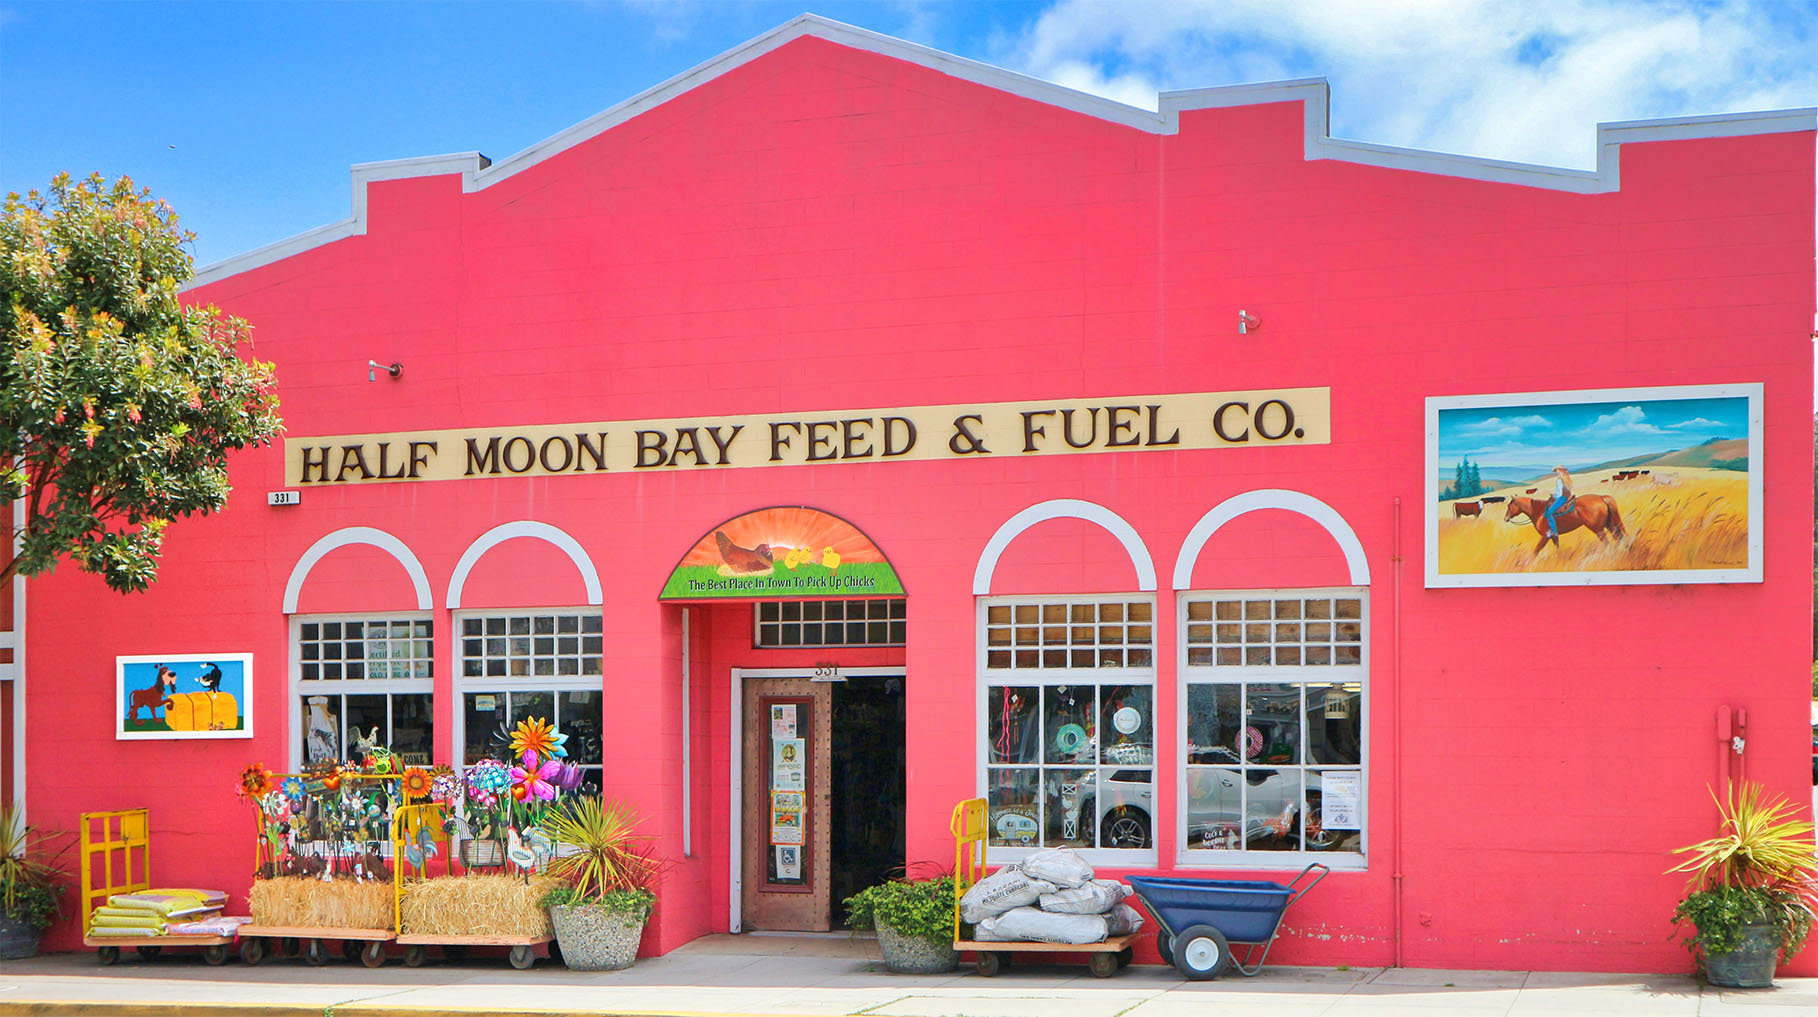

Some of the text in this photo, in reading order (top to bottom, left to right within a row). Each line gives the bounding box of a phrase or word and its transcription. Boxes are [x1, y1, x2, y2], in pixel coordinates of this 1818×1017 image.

[299, 399, 1305, 483] HALF MOON BAY FEED & FUEL CO.
[274, 493, 289, 503] 331
[689, 575, 875, 591] The Best Place In Town To Pick Up Chicks
[815, 662, 839, 676] 331
[403, 754, 425, 764] COME
